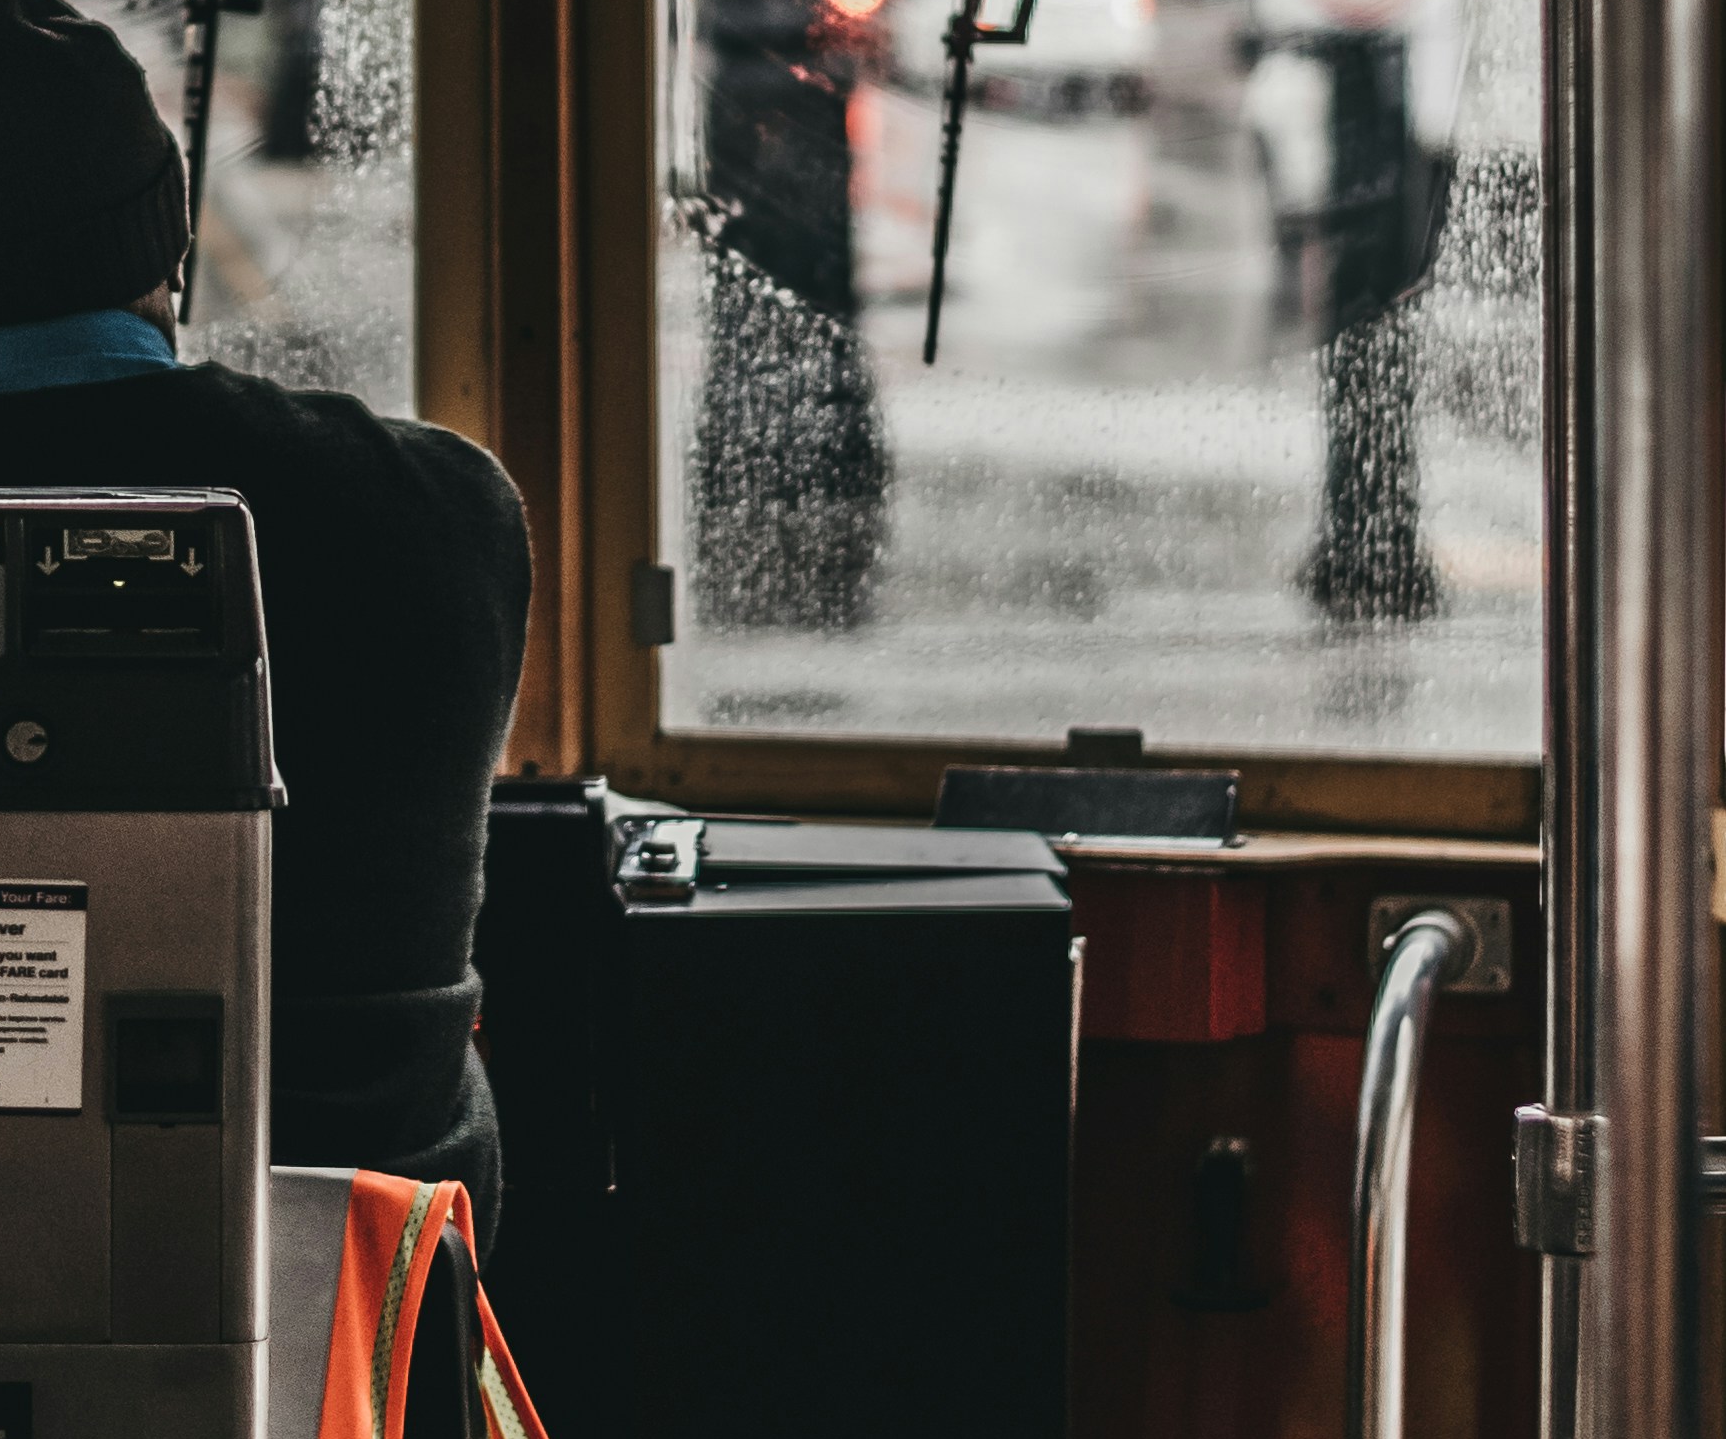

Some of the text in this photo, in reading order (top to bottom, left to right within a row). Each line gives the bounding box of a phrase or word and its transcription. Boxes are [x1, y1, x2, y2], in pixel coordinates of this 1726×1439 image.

[1, 890, 32, 903] Your
[26, 950, 57, 962] want
[39, 967, 69, 979] card
